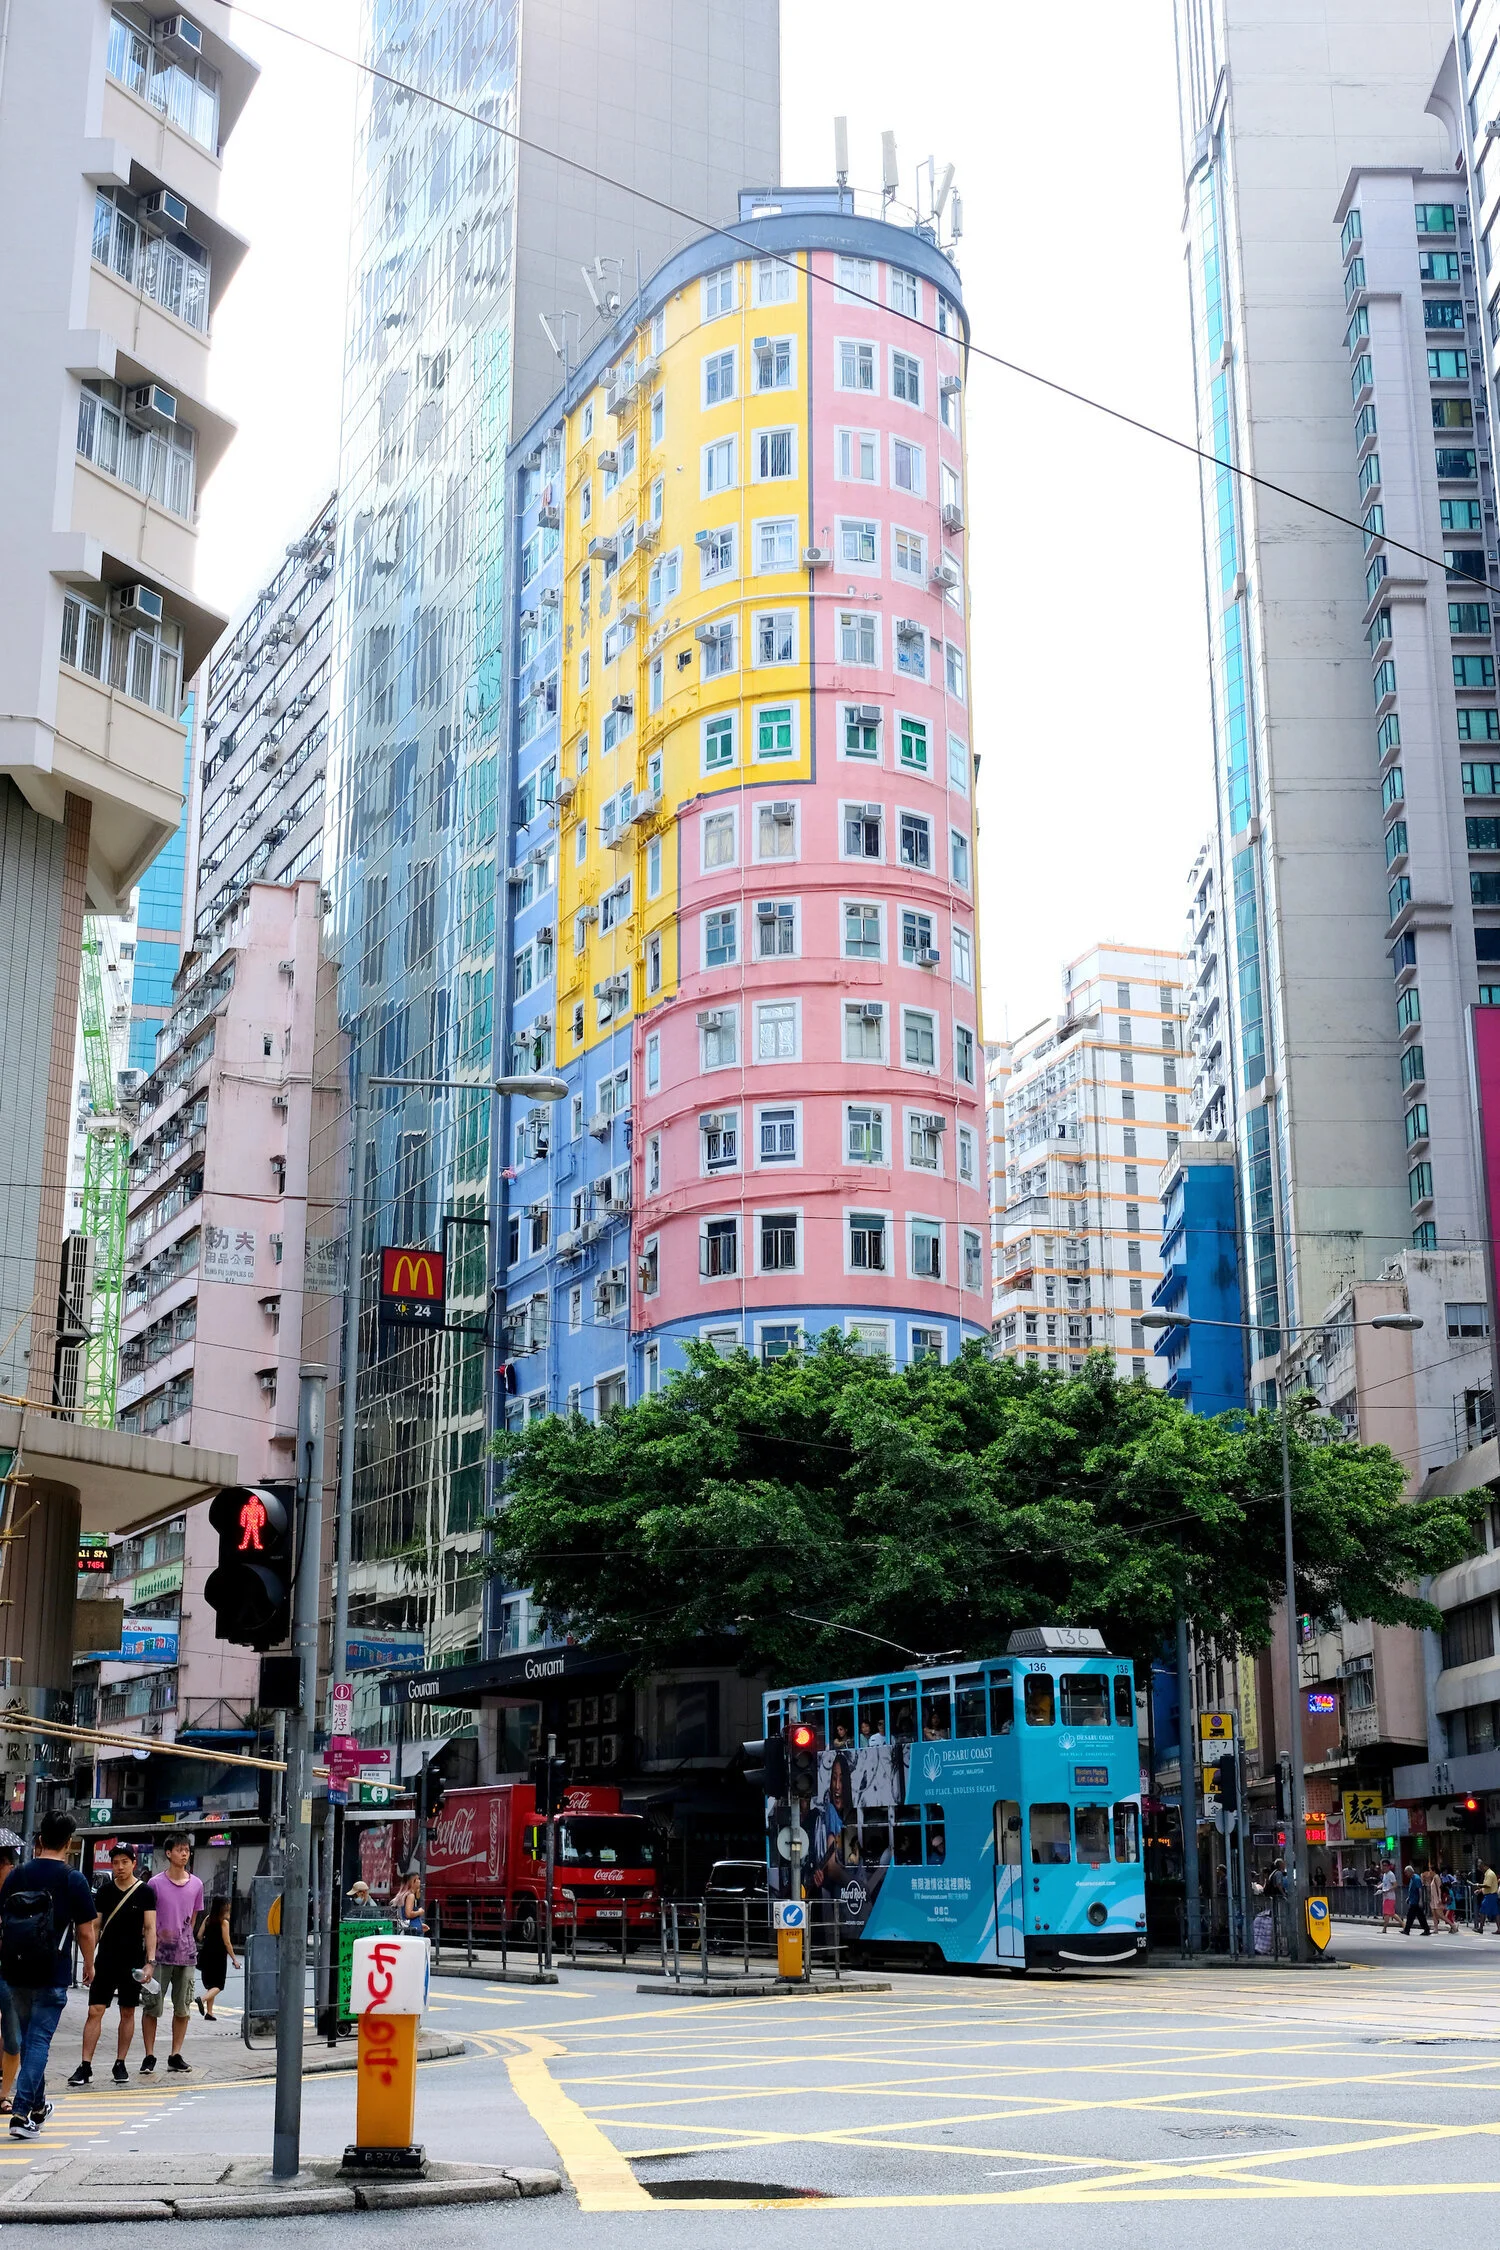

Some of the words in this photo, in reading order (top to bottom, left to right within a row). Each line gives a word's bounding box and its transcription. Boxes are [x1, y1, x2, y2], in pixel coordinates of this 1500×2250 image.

[205, 1252, 254, 1267] 用品公司
[414, 1304, 431, 1317] 24
[94, 1550, 108, 1558] SPA
[1056, 1629, 1089, 1645] 136
[525, 1654, 565, 1679] Gourami
[1029, 1663, 1046, 1672] 136
[1116, 1665, 1128, 1674] 136
[408, 1677, 439, 1699] Gourami
[334, 1703, 348, 1731] 灣仔
[1222, 1742, 1228, 1750] 7
[943, 1749, 969, 1761] DESARU
[970, 1747, 993, 1759] COAST
[953, 1786, 975, 1794] ENDLESS
[841, 1888, 854, 1899] Hard
[854, 1888, 866, 1901] Rock
[1136, 1937, 1147, 1947] 136
